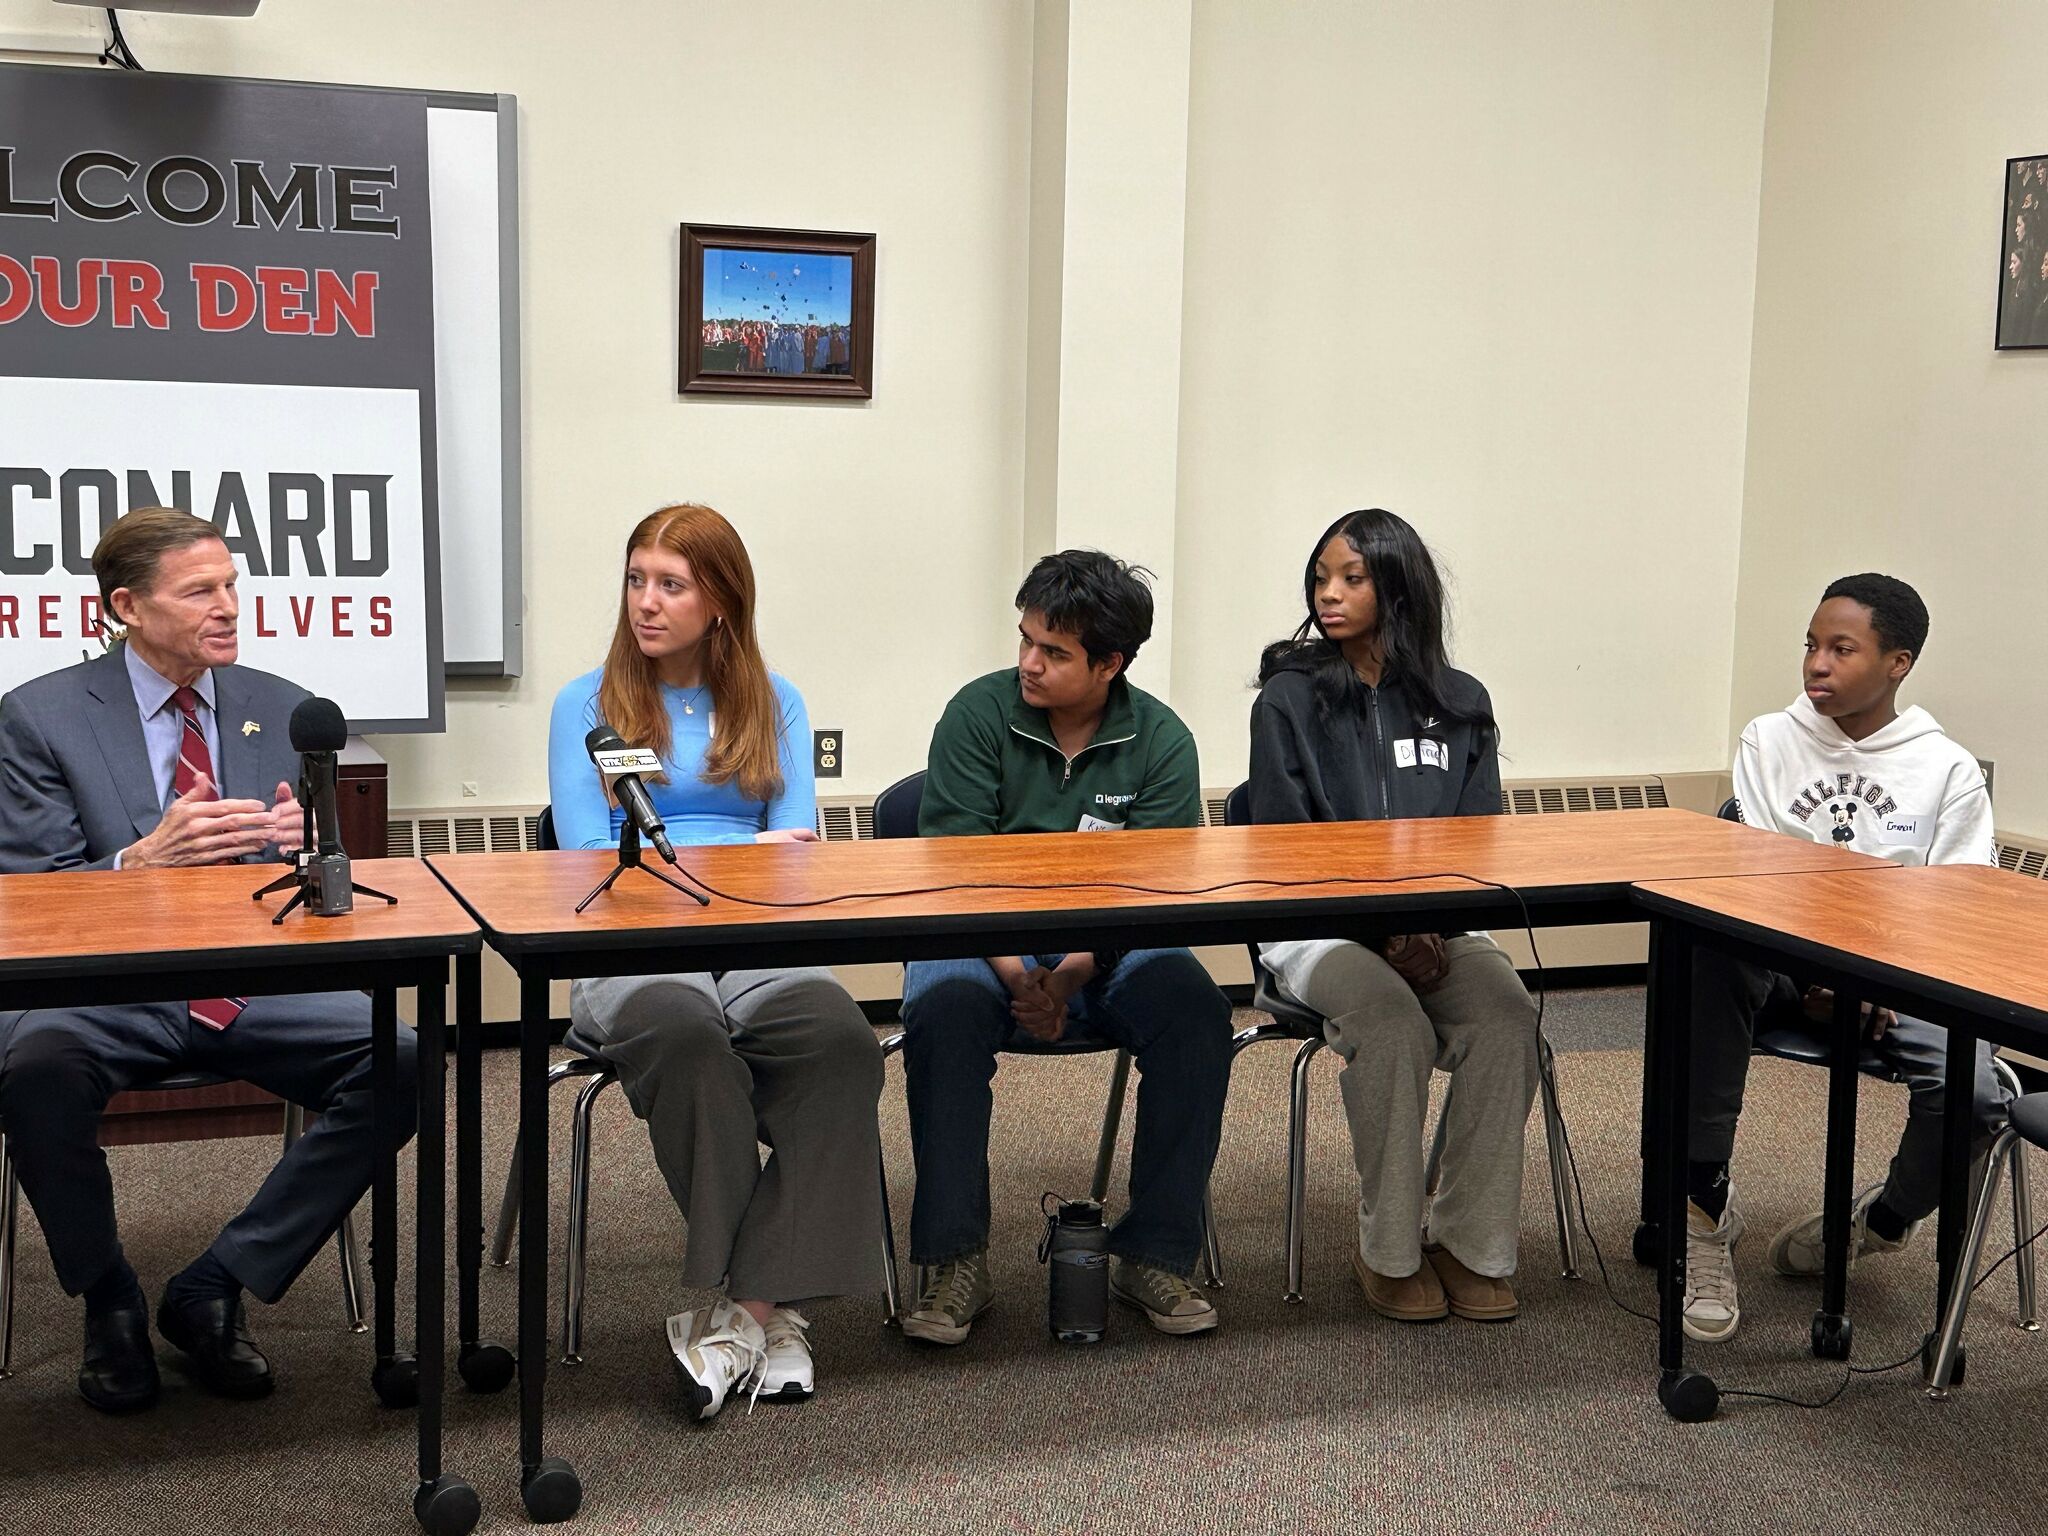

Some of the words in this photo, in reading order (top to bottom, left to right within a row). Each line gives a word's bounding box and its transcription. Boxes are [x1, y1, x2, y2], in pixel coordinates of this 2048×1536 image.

[0, 146, 401, 239] LCOME
[190, 262, 379, 338] DEN
[0, 595, 104, 638] RED
[256, 596, 392, 637] LVES
[1788, 773, 1898, 822] HILFIGE
